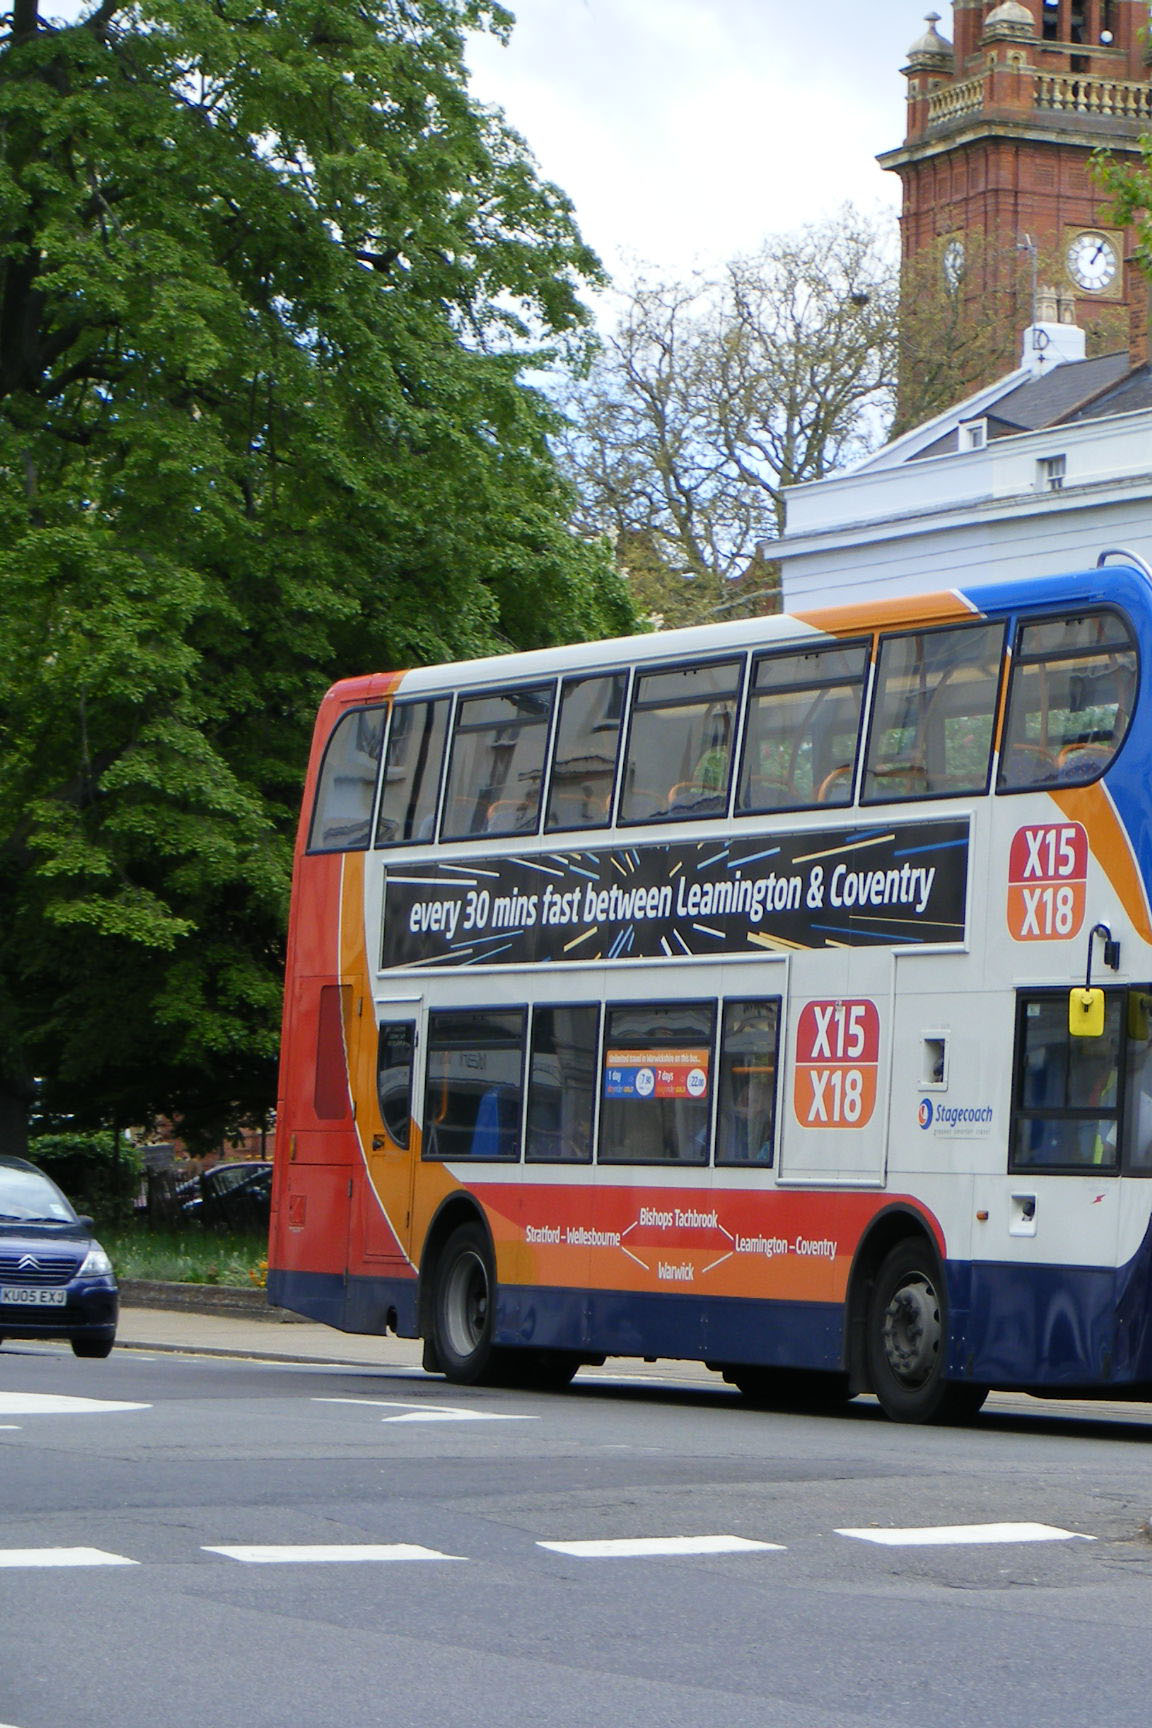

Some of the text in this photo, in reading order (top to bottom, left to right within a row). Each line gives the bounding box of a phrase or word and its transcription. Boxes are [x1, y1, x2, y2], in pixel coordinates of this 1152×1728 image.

[1023, 828, 1076, 878] X15
[410, 862, 936, 939] every 30 mins fast between Leamington & Coventry
[1020, 886, 1074, 936] X18
[810, 1005, 866, 1058] X15
[808, 1069, 864, 1122] X18
[935, 1104, 993, 1127] Stagecoach
[640, 1208, 718, 1229] Bishops Tachbrook
[526, 1225, 560, 1243] Stratford
[567, 1227, 621, 1246] Wellesbourne
[735, 1236, 788, 1257] Leamington
[796, 1236, 837, 1260] Coventry
[658, 1262, 694, 1281] Warwick
[4, 1290, 65, 1303] KU05 EXJ
